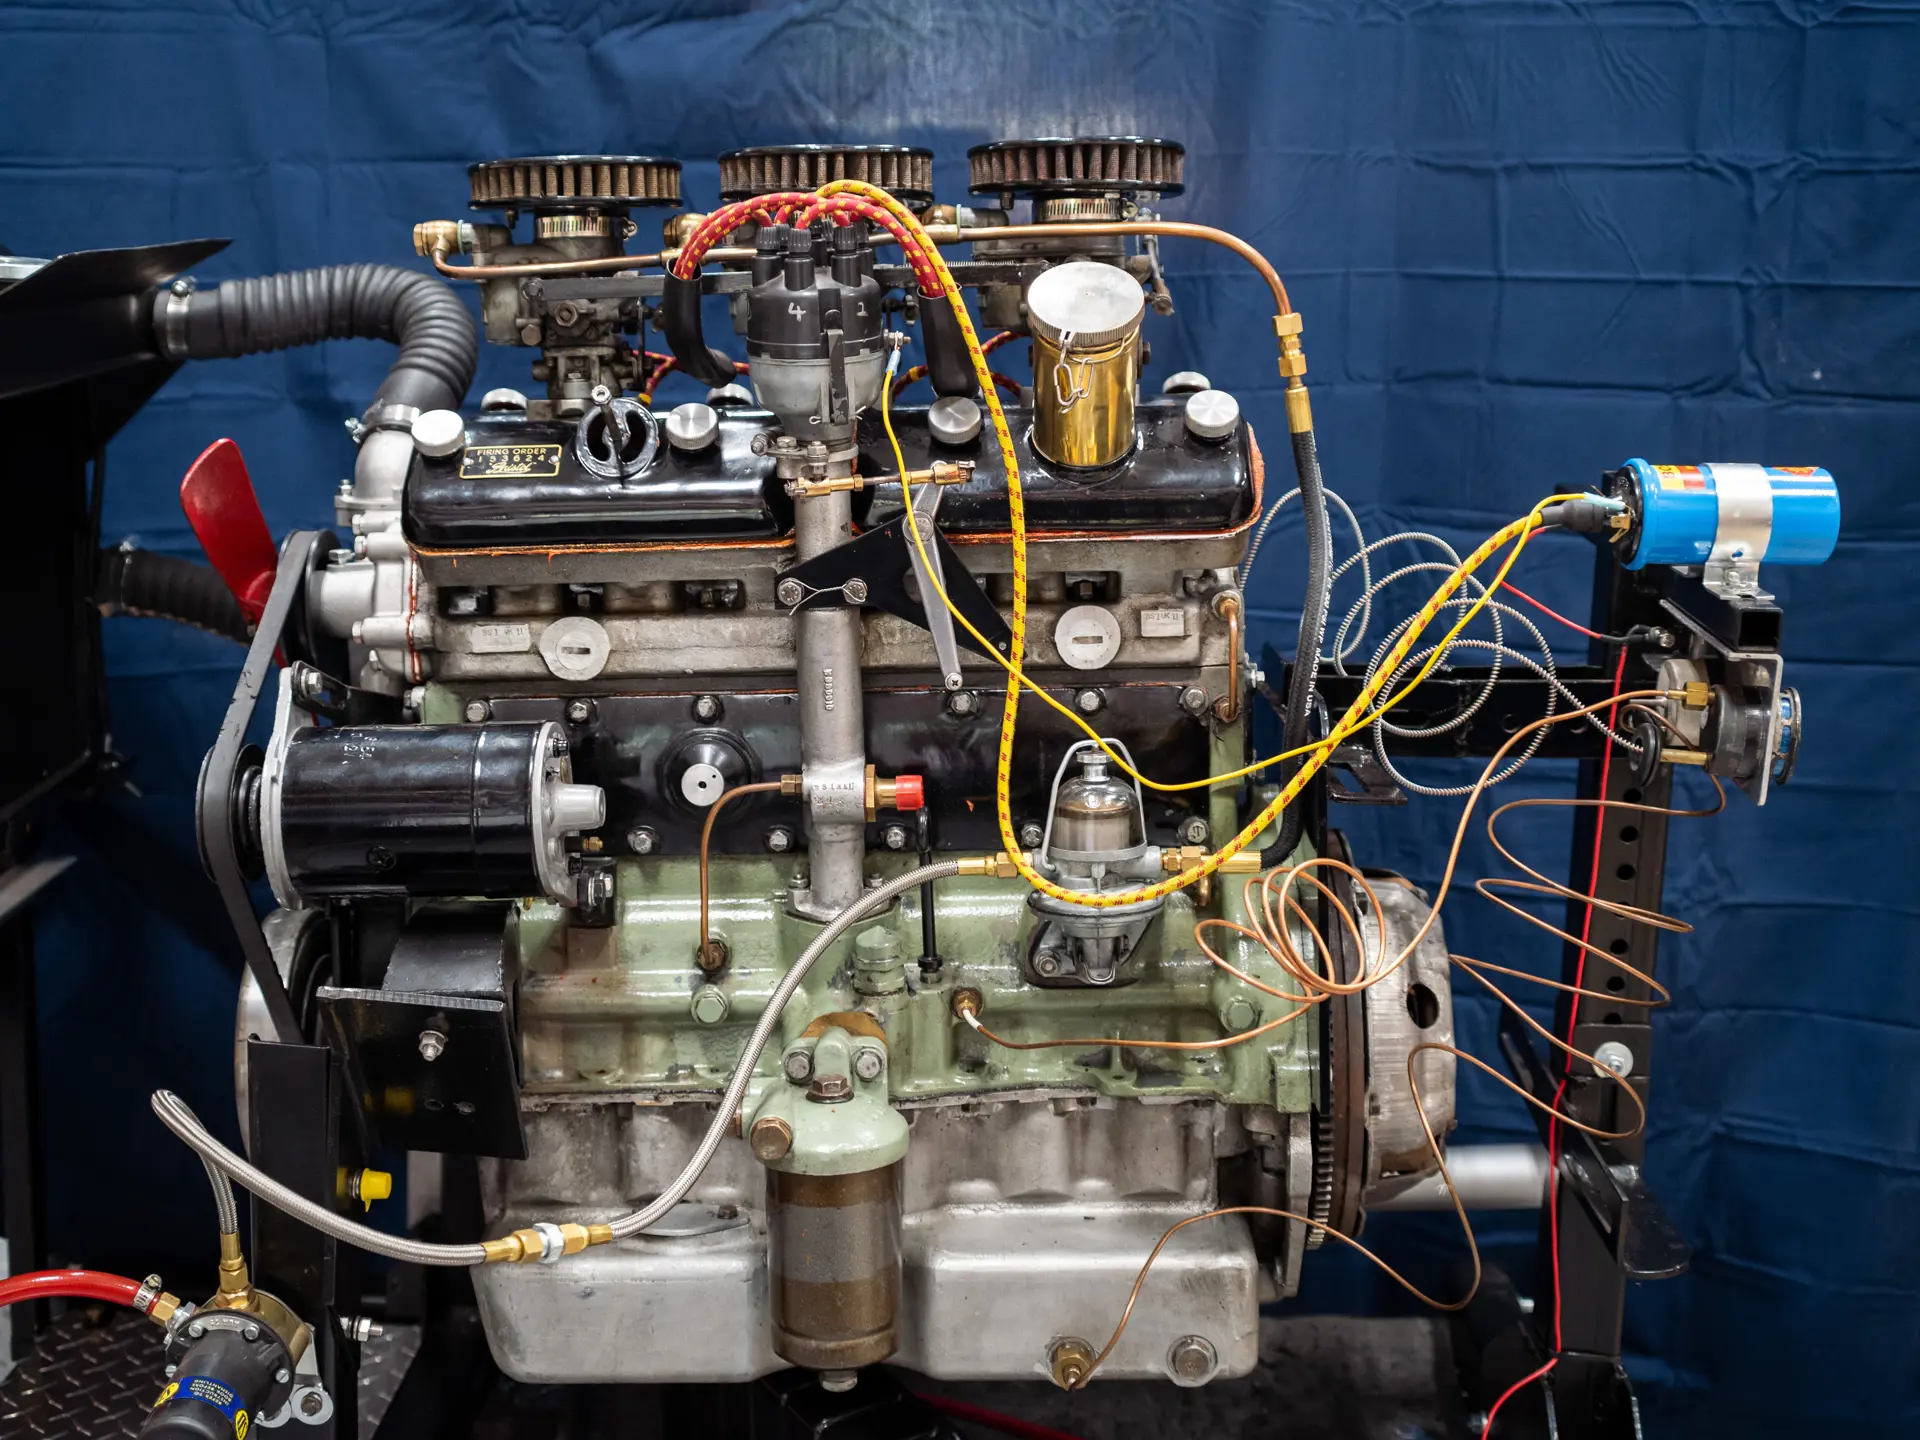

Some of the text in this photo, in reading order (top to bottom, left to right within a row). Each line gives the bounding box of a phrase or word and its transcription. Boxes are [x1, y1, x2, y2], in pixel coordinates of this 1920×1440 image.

[788, 302, 807, 322] 4
[477, 447, 547, 456] FIRING ORDER
[1310, 647, 1321, 680] MADE
[1308, 680, 1316, 692] IN
[1304, 694, 1313, 717] USA
[189, 1386, 230, 1406] INSTRUCTION
[192, 1383, 232, 1402] BOOK BEFORE
[204, 1393, 222, 1406] REFER
